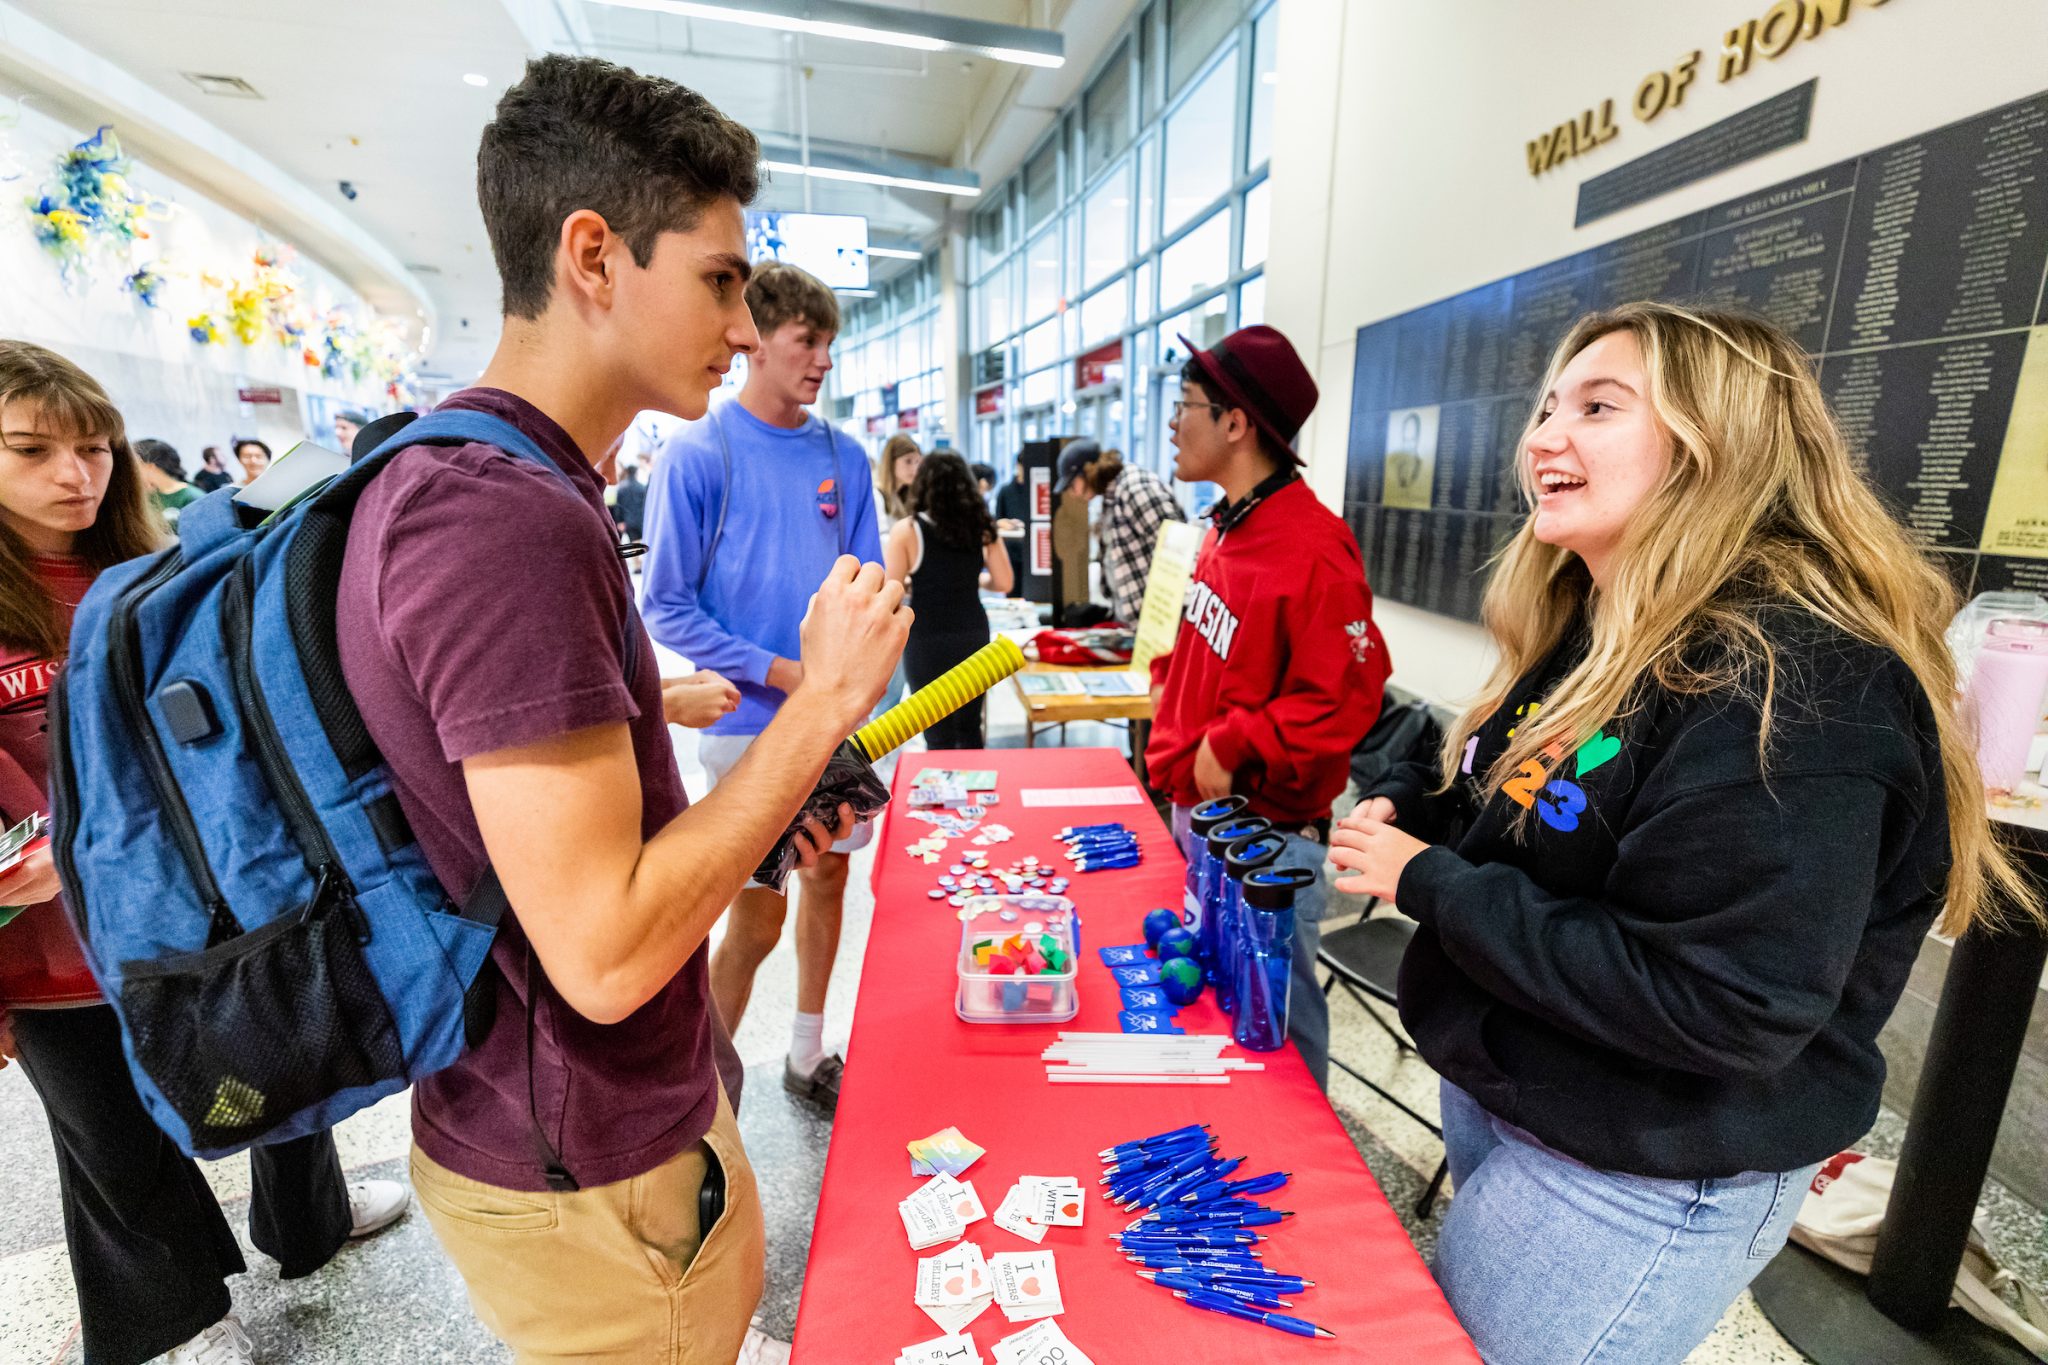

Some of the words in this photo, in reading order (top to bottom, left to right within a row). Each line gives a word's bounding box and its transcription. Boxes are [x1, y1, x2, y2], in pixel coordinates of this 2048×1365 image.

[1526, 99, 1619, 176] WALL
[1633, 50, 1701, 122] OF
[1718, 0, 1892, 83] HON
[0, 659, 69, 698] WIS
[937, 1192, 958, 1227] DEJOPE
[1044, 1189, 1058, 1222] WITTE
[931, 1259, 942, 1302] SELLERY
[1002, 1261, 1019, 1301] WATERS
